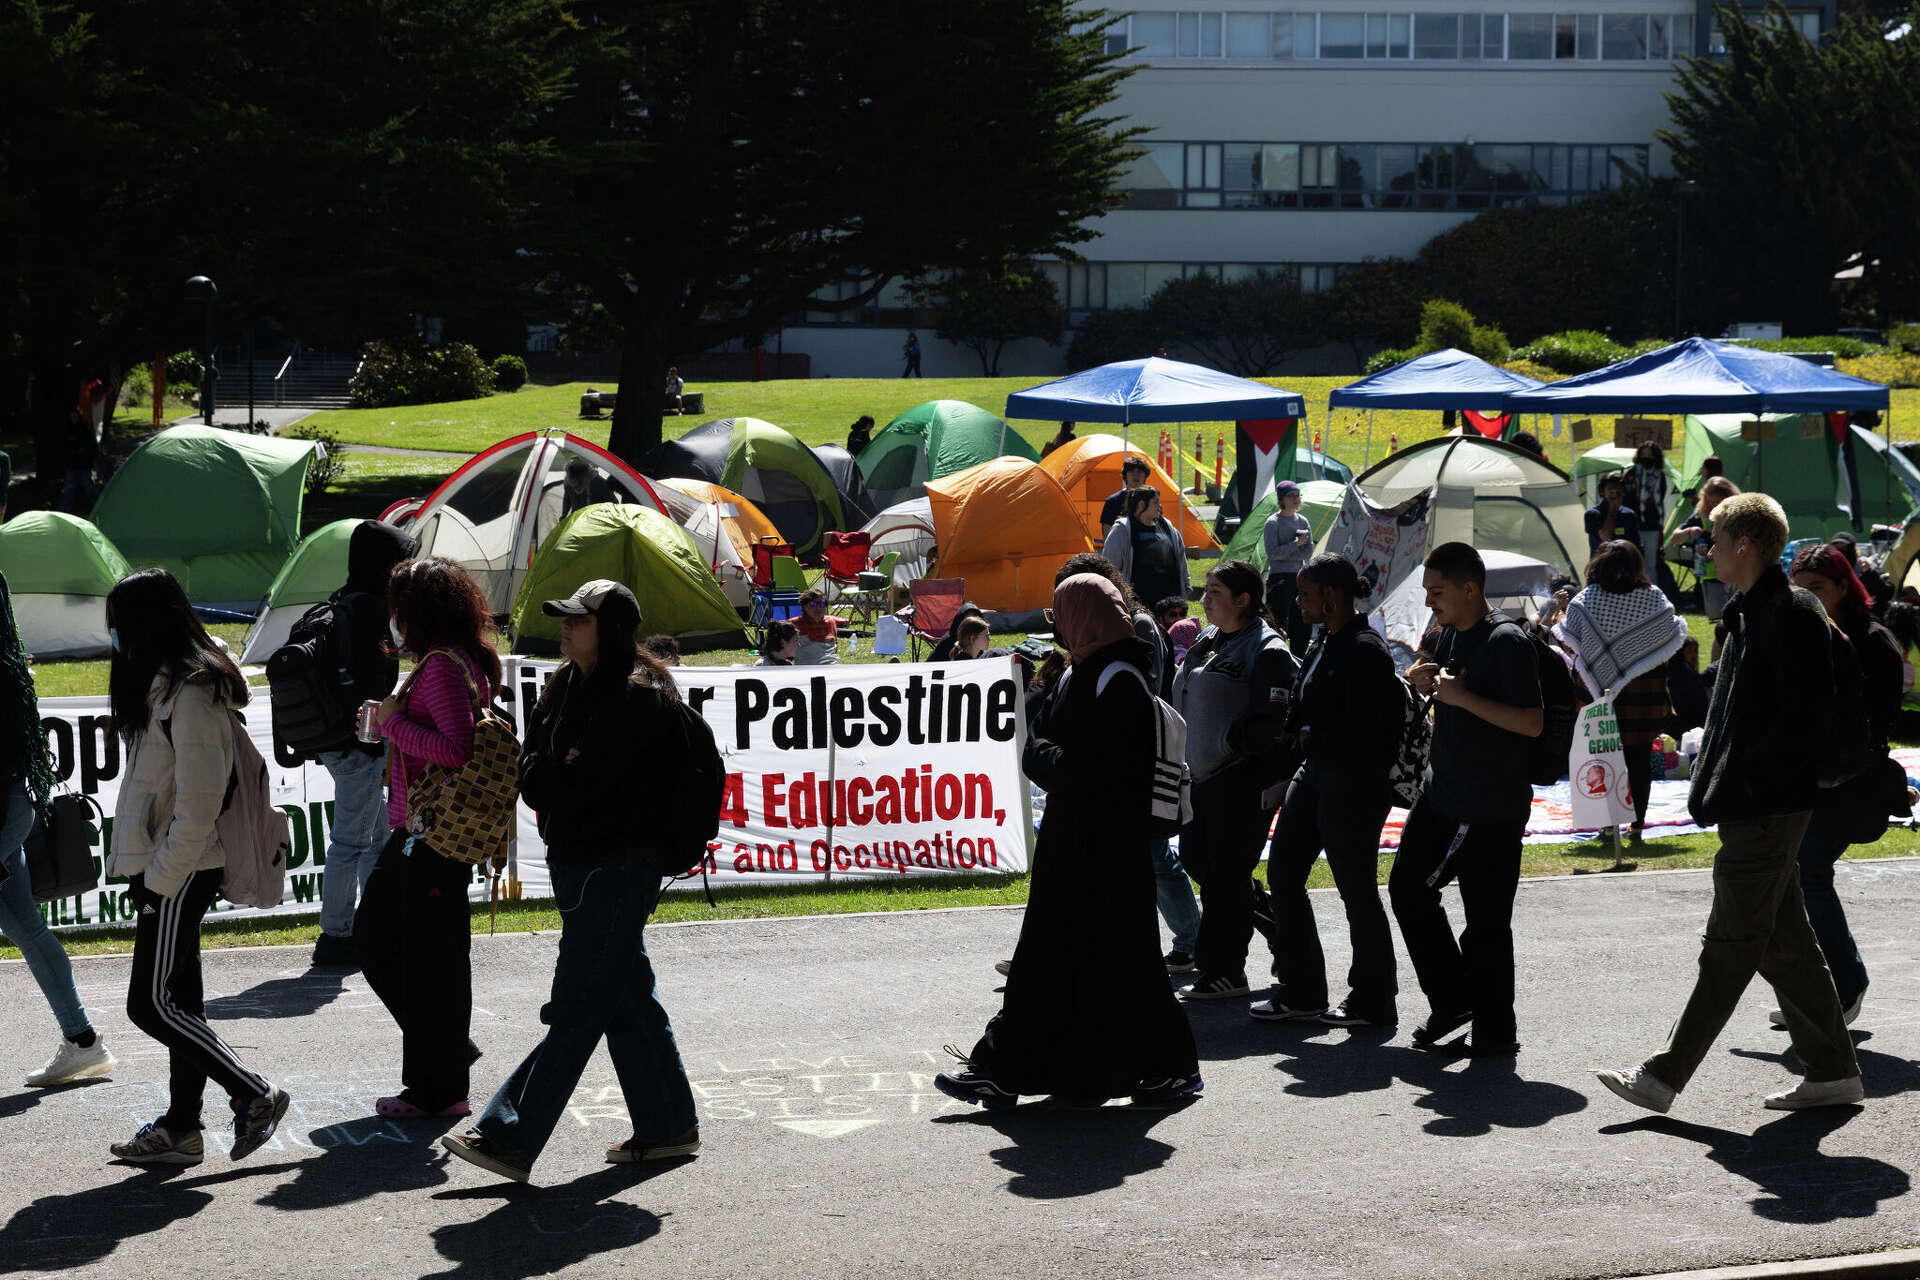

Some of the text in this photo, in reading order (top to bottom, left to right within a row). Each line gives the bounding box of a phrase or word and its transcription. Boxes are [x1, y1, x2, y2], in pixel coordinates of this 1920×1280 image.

[735, 670, 1016, 751] Palestine
[1584, 703, 1608, 720] THERE
[1584, 720, 1620, 737] 2 SID
[1589, 737, 1623, 754] GENOC
[762, 764, 1006, 829] Education,
[733, 839, 798, 873] and
[811, 830, 997, 874] Occupation
[99, 891, 136, 923] NO
